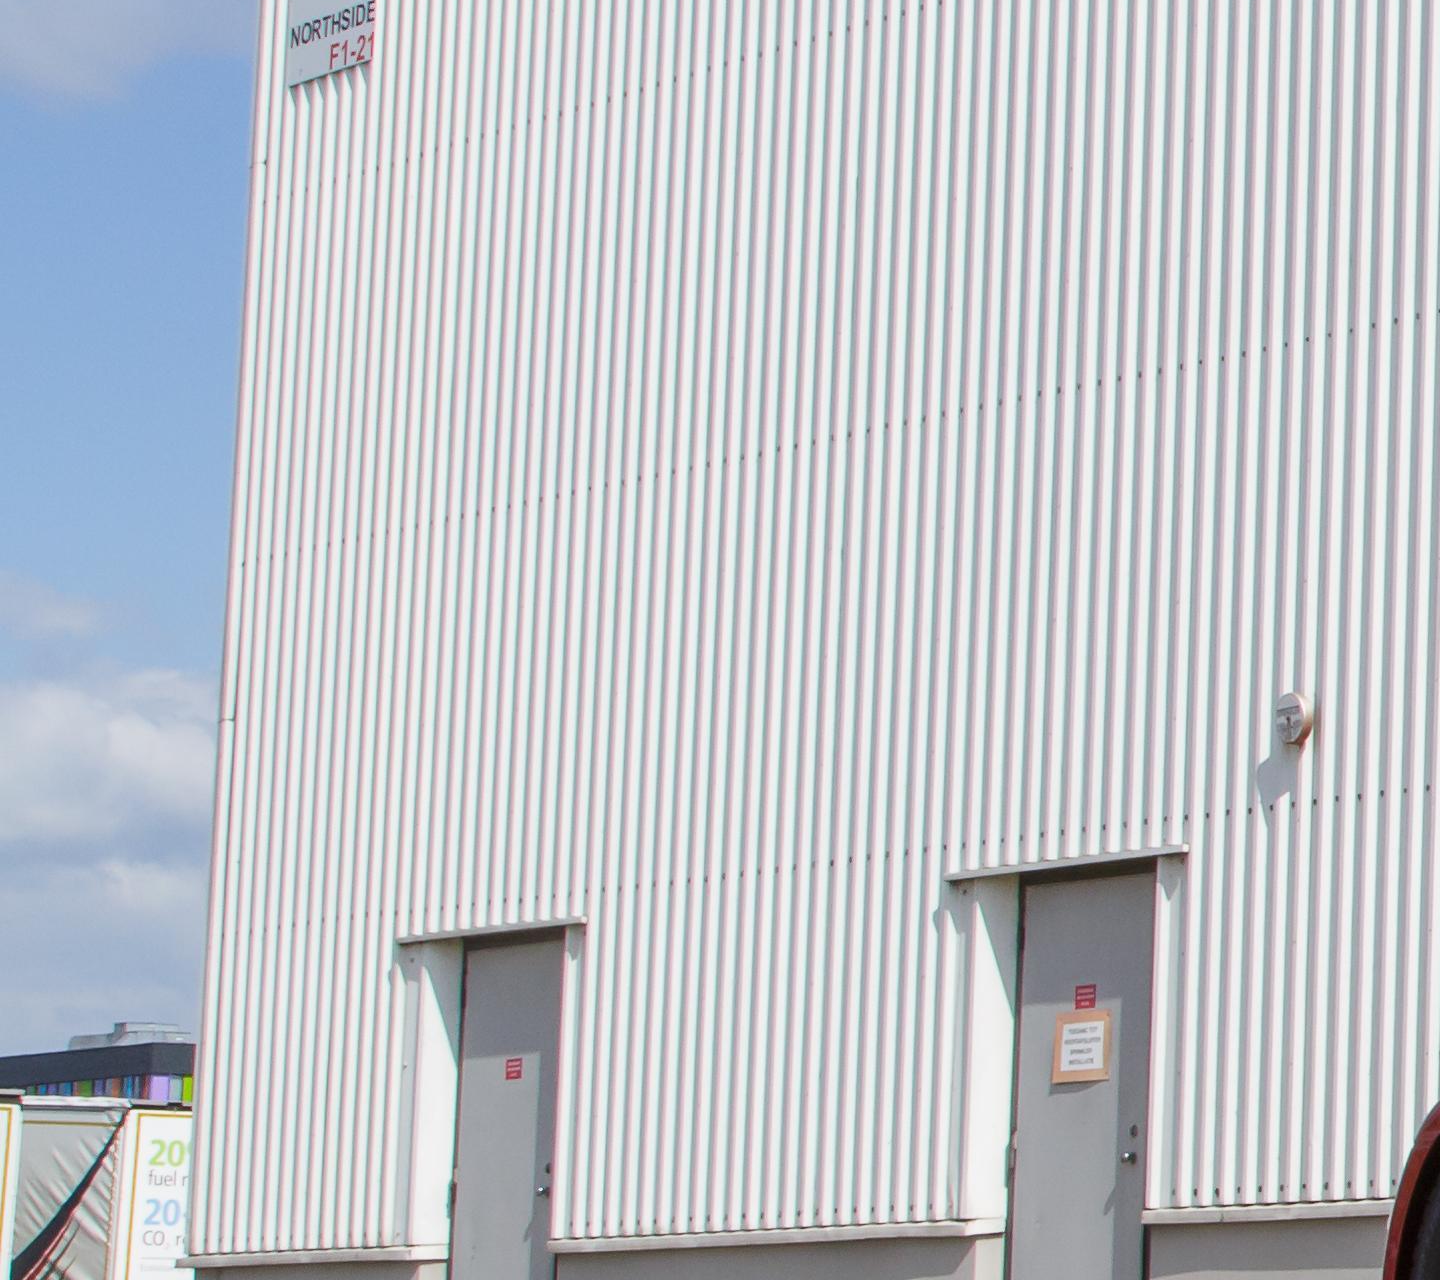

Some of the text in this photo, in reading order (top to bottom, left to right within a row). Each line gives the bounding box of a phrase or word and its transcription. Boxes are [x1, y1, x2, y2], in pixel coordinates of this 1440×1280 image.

[290, 0, 376, 49] NORTHSIDE
[329, 31, 375, 70] F1-21
[148, 1168, 178, 1187] fuel
